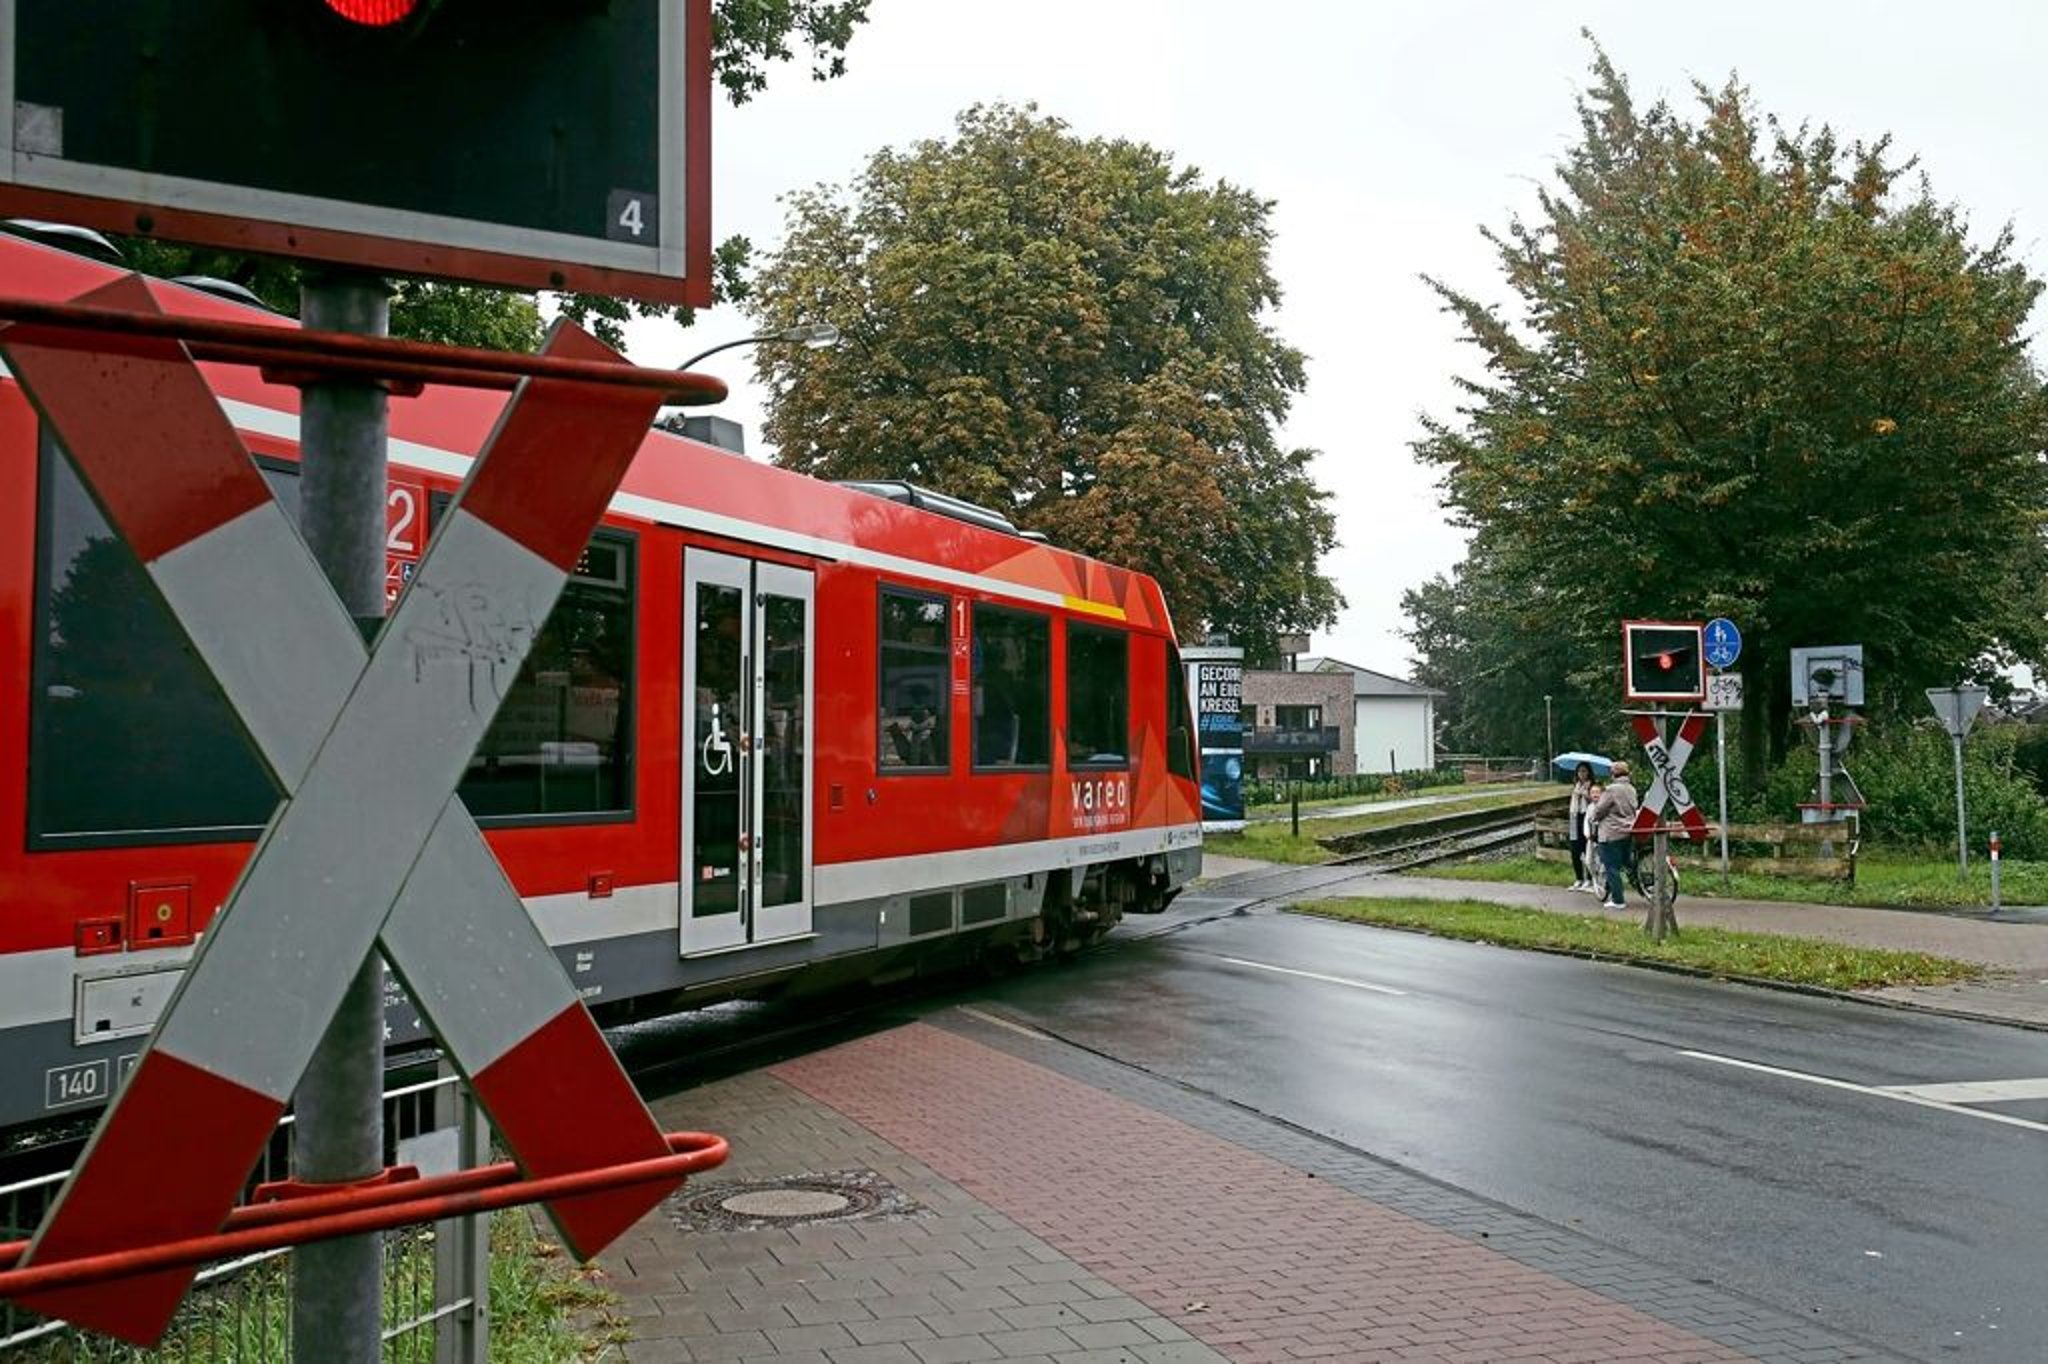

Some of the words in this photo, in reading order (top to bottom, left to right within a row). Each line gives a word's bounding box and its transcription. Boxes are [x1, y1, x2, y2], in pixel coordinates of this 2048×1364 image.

[619, 199, 644, 235] 4
[386, 488, 415, 551] 2
[957, 600, 965, 637] 1
[1200, 681, 1217, 697] AN
[1071, 781, 1126, 809] vareo
[59, 1069, 97, 1099] 140
